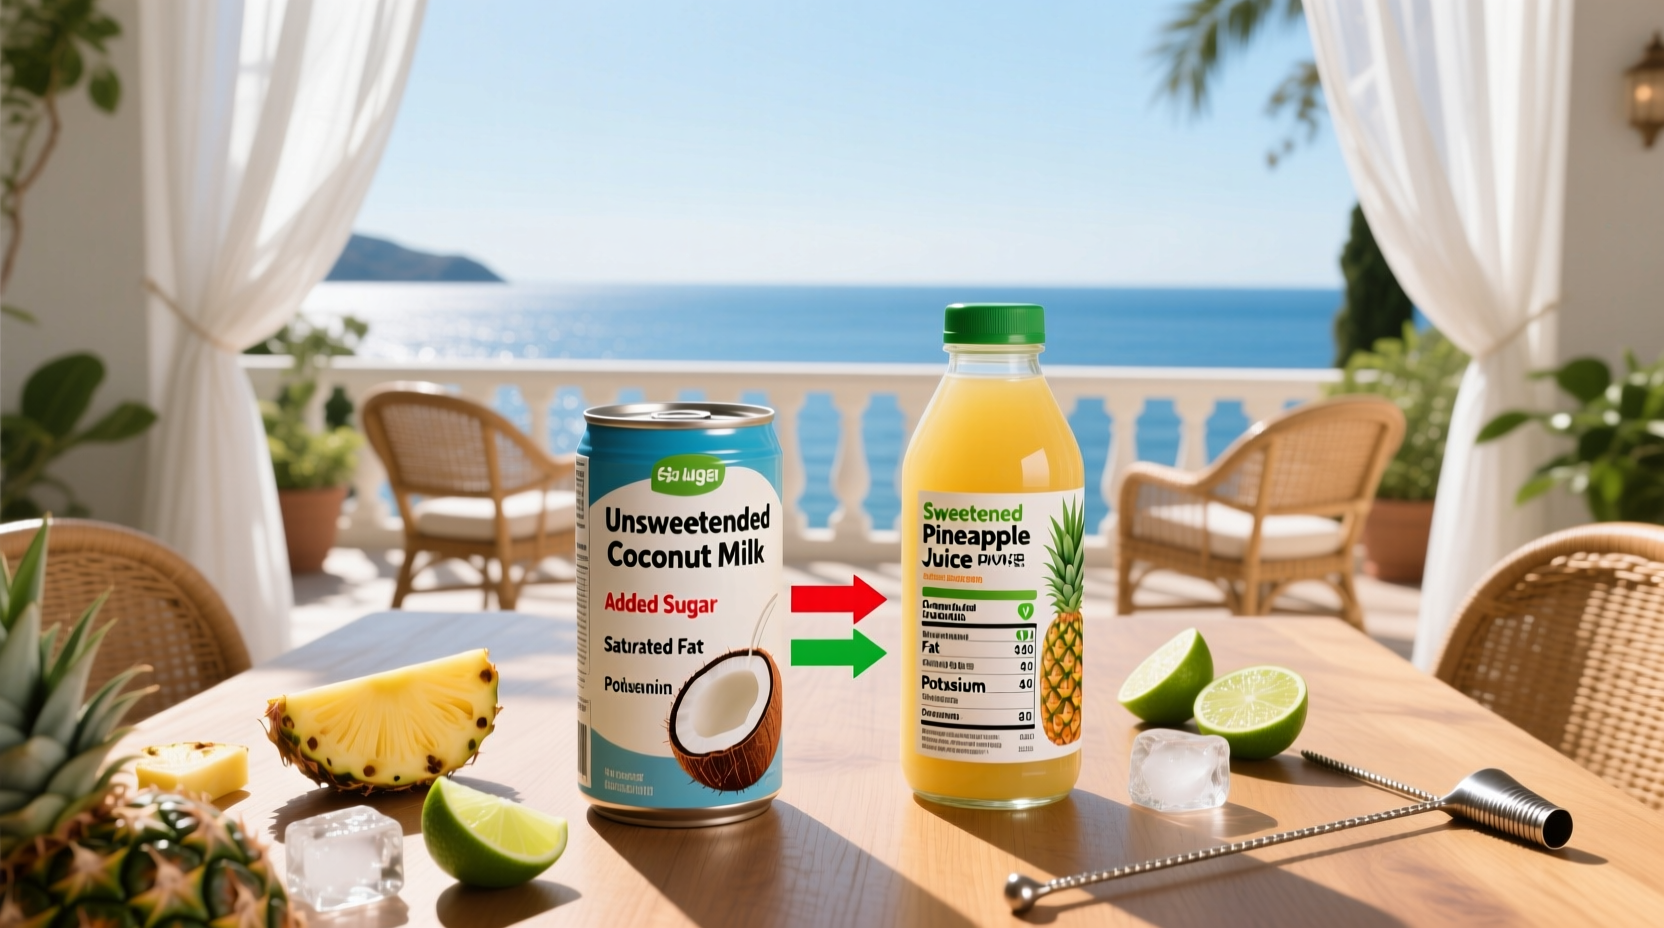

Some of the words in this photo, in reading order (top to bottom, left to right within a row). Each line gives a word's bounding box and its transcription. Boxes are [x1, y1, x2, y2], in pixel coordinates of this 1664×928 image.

[605, 503, 770, 534] Unsweetended
[923, 501, 1023, 522] Sweetened
[923, 523, 1031, 551] Pineapple
[607, 541, 712, 568] Coconut
[718, 538, 765, 567] Milk
[922, 547, 973, 568] Juice
[604, 592, 659, 613] Added
[663, 594, 718, 618] Sugar
[678, 637, 704, 655] Fat
[922, 640, 940, 654] Fat
